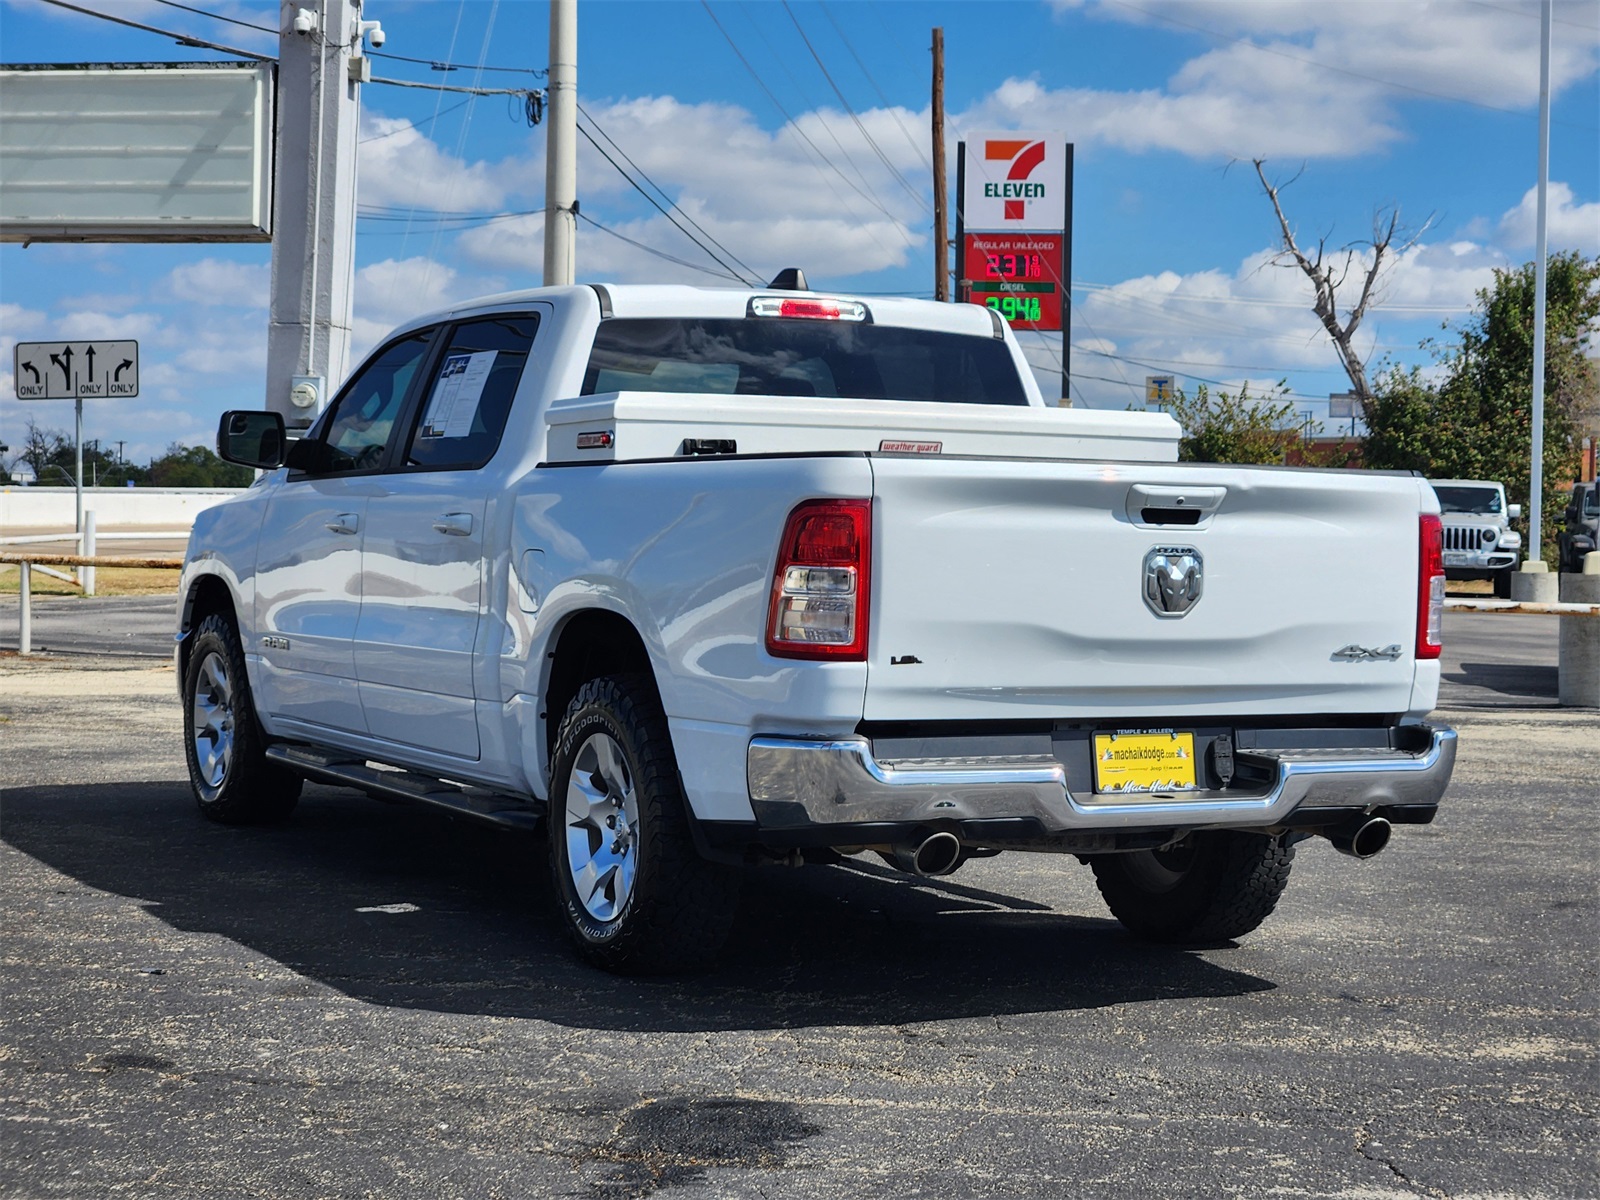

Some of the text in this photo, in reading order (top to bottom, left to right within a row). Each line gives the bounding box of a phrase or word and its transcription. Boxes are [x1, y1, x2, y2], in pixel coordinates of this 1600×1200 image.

[985, 140, 1045, 220] 7
[973, 241, 1054, 250] REGULAR UNLEADED
[1000, 283, 1026, 291] DIESEL
[20, 386, 43, 395] ONLY
[80, 385, 102, 394] ONLY
[110, 384, 134, 393] ONLY
[883, 442, 939, 453] weather guard
[1114, 746, 1175, 761] machaikdodge.com
